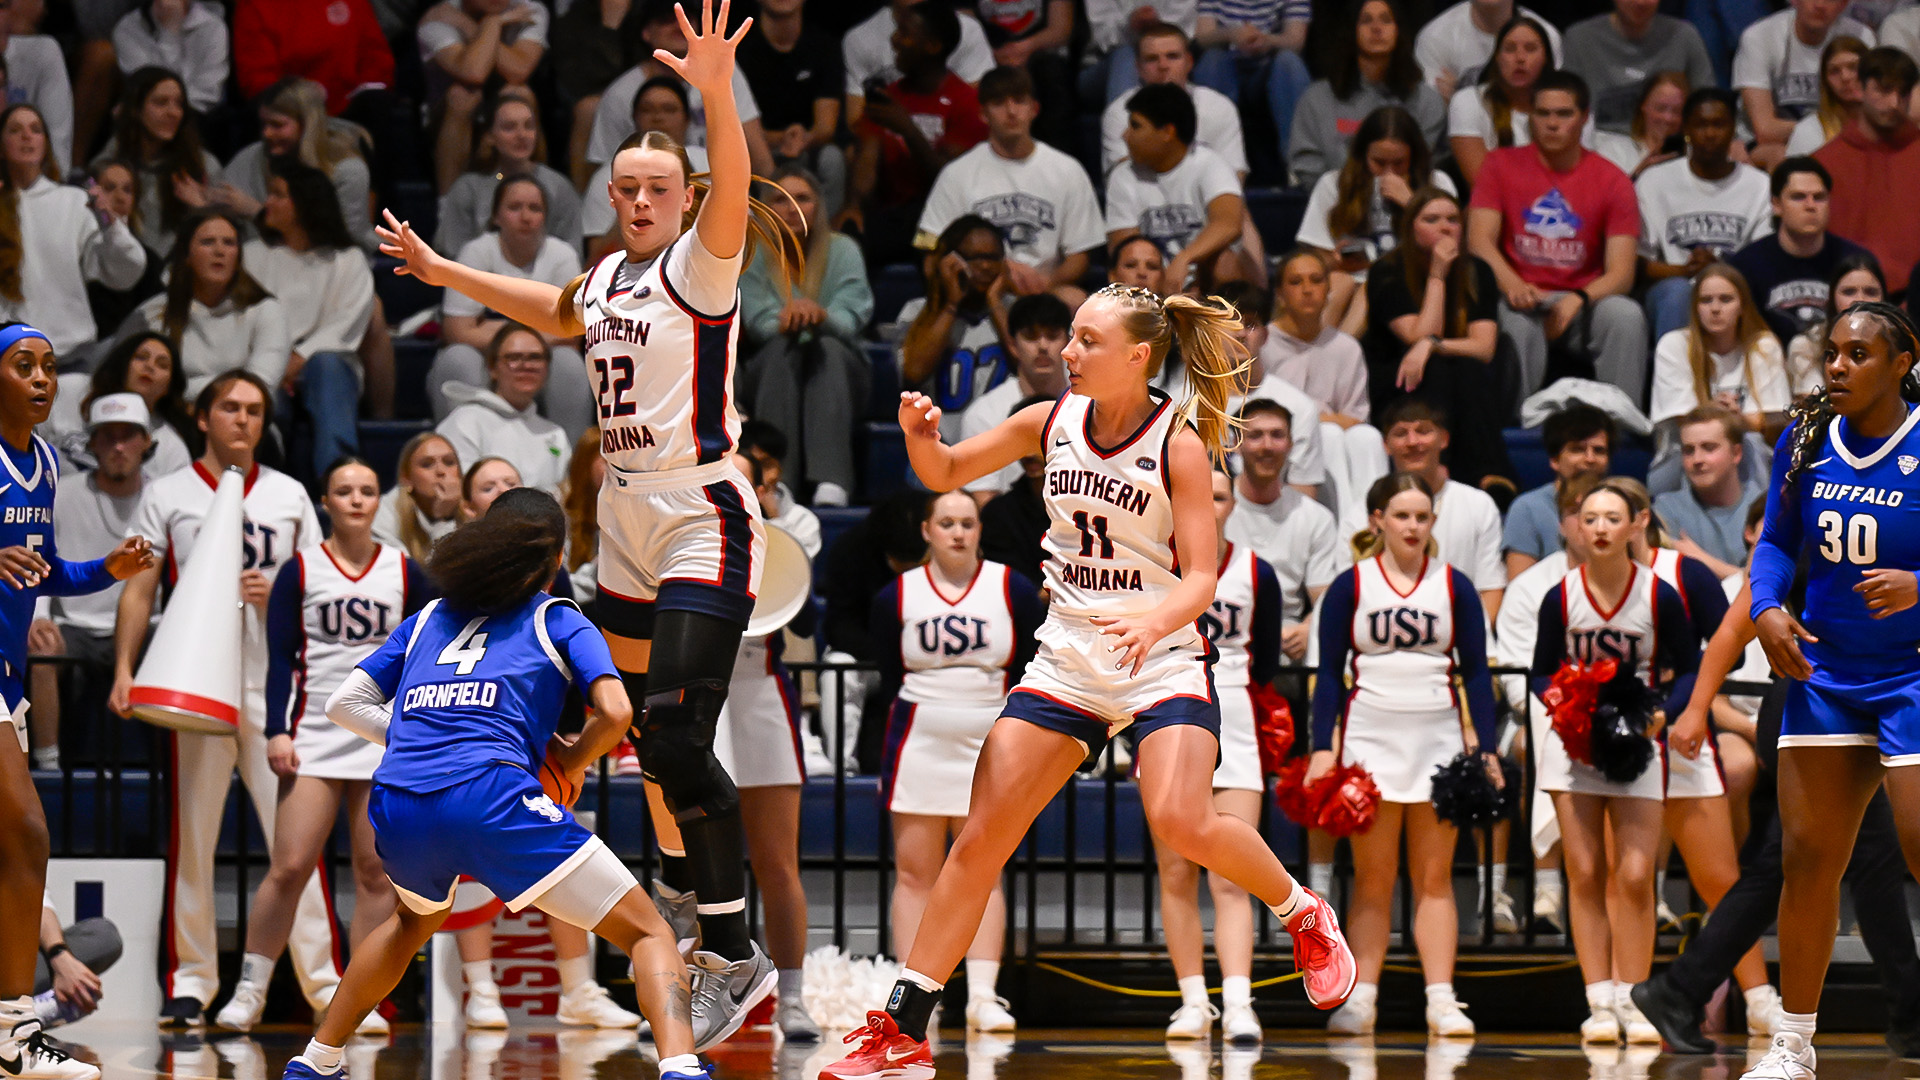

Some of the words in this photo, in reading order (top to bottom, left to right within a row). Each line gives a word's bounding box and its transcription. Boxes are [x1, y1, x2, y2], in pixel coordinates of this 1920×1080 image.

[593, 355, 637, 419] 22
[1049, 469, 1152, 517] SOUTHERN
[1812, 481, 1904, 508] BUFFALO
[242, 519, 278, 570] SI
[1072, 510, 1115, 560] 11
[1817, 510, 1878, 565] 30
[319, 597, 390, 640] USI
[917, 615, 988, 656] USI
[1202, 600, 1241, 643] SI
[1367, 607, 1439, 648] USI
[435, 615, 489, 676] 4
[1573, 629, 1642, 666] USI
[402, 681, 498, 713] CORNFIELD
